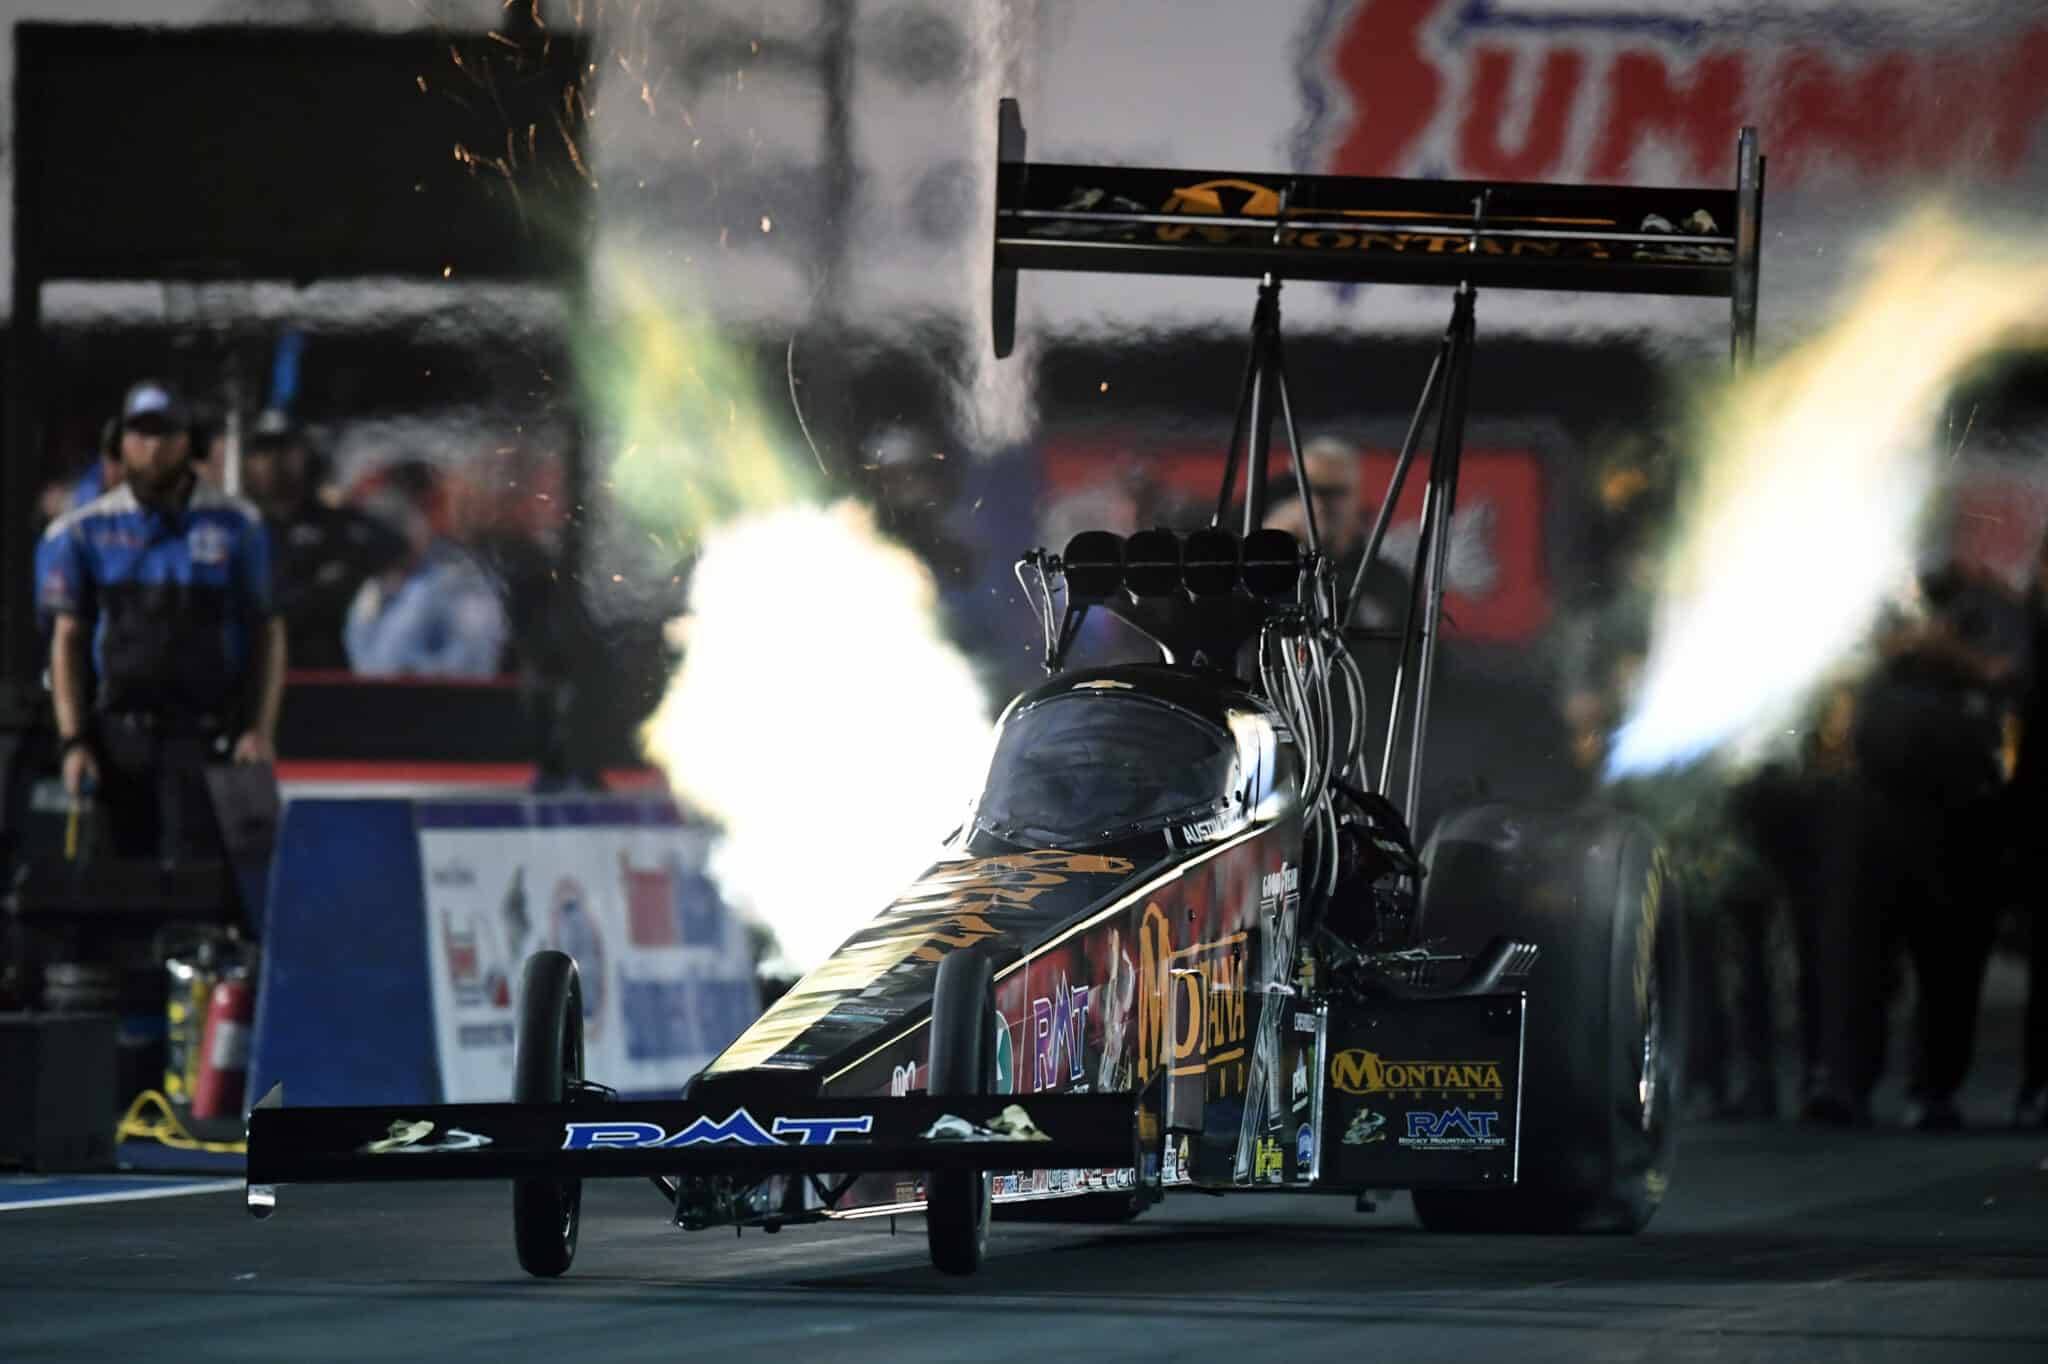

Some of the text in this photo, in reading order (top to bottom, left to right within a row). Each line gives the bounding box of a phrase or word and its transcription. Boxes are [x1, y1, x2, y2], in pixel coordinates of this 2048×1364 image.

[1033, 970, 1089, 1093] RMT
[1331, 1049, 1503, 1094] MONTANA
[562, 1106, 873, 1150] RMT
[1406, 1107, 1499, 1137] RMT
